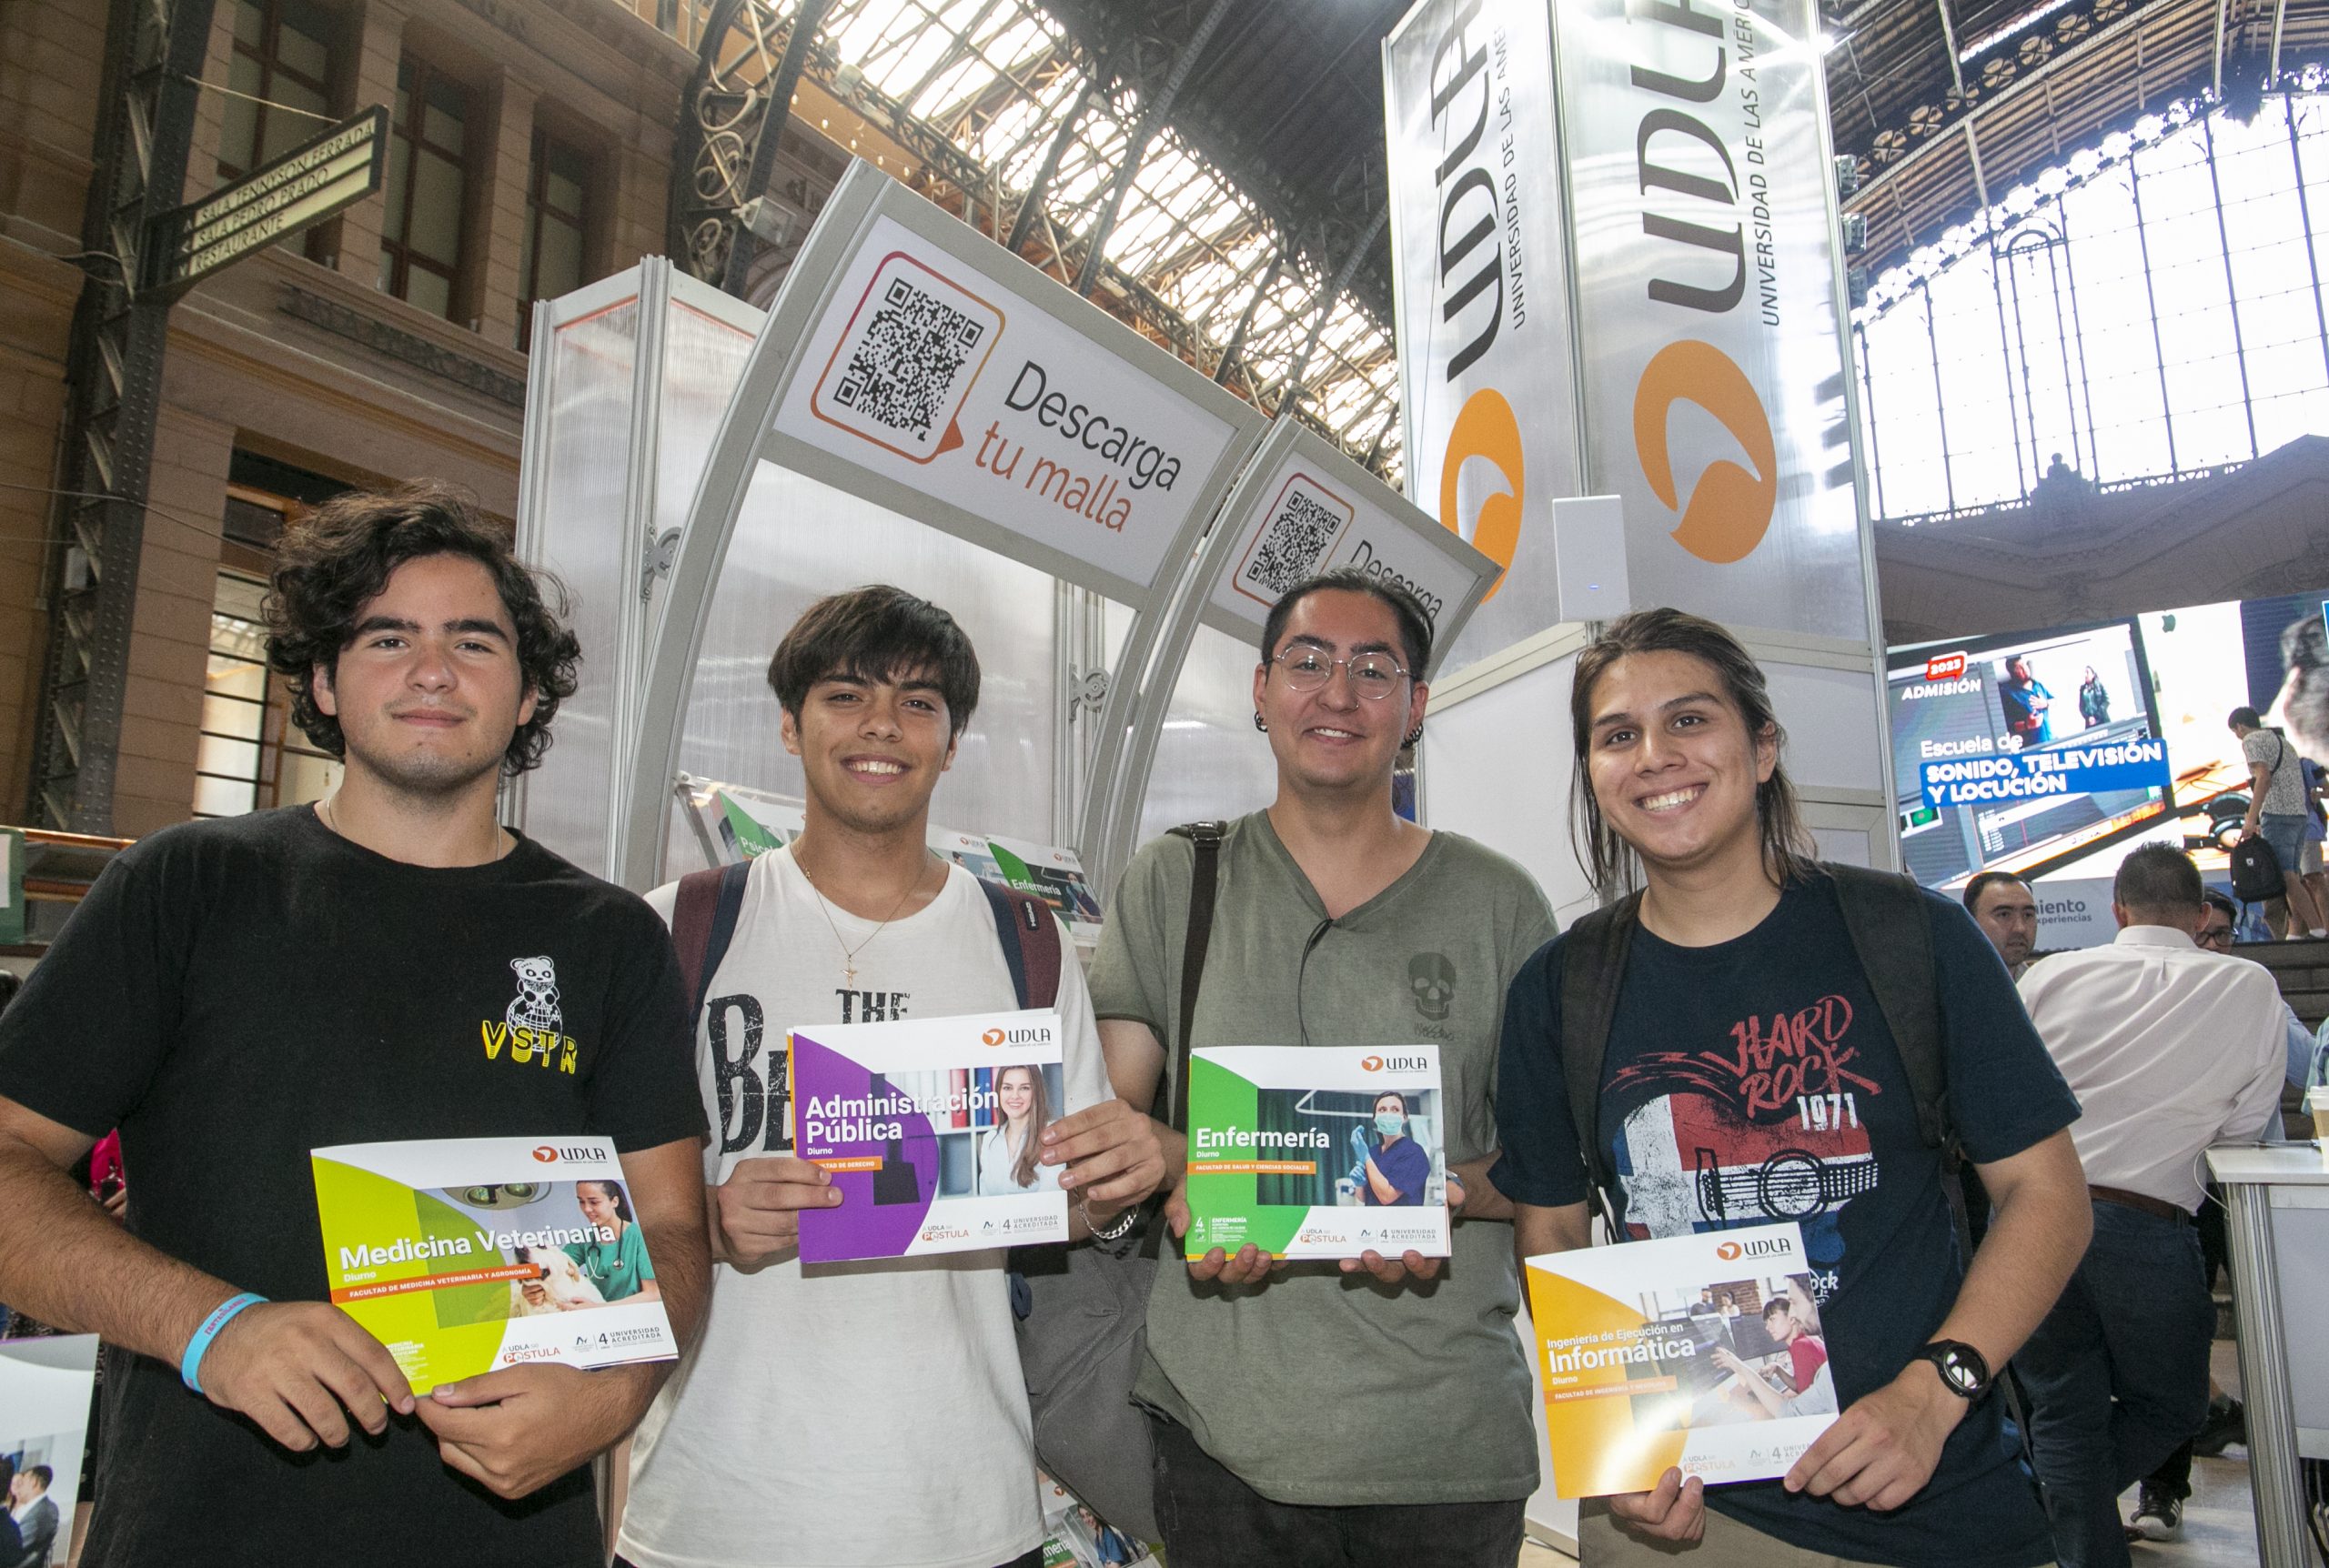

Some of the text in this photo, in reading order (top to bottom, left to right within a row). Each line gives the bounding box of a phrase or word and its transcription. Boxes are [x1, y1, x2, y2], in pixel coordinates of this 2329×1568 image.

[1498, 86, 1513, 129] LAS
[1740, 88, 1761, 129] LAS
[1502, 133, 1516, 169] DE
[1745, 136, 1767, 166] DE
[201, 201, 230, 221] SALA
[312, 123, 372, 166] FERRADA
[197, 167, 328, 246] SALA PEDRO PRADO
[195, 213, 284, 268] RESTAURANTE
[1506, 173, 1526, 330] UNIVERSIDAD
[1749, 174, 1780, 327] UNIVERSIDAD
[1004, 360, 1181, 492] Descarga
[975, 420, 1132, 533] tu malla
[1901, 678, 1981, 700] ADMISIÓN
[1920, 737, 1992, 759] Escuela
[1926, 741, 2163, 783] SONIDO, TELEVISIÓN
[1927, 773, 2067, 804] Y LOCUCIÓN
[1011, 879, 1063, 896] Enfermería
[835, 989, 911, 1024] THE
[482, 1020, 578, 1075] VSTR
[1008, 1028, 1051, 1044] UDLA
[1726, 994, 1853, 1078] HARD
[1386, 1057, 1427, 1070] UDLA
[1739, 1043, 1882, 1120] ROCK
[805, 1084, 999, 1120] Administración
[1796, 1092, 1859, 1131] 1971
[806, 1119, 902, 1144] Pública
[1195, 1126, 1331, 1149] Enfermería
[560, 1148, 607, 1161] UDLA
[807, 1147, 832, 1156] Diurno
[1013, 1214, 1059, 1224] UNIVERSIDAD
[339, 1221, 616, 1271] Medicina Veterinaria
[1380, 1229, 1388, 1240] 4
[1744, 1238, 1791, 1256] UDLA
[343, 1271, 377, 1282] Diurno
[349, 1285, 388, 1298] FACULTAD
[399, 1280, 436, 1290] MEDICINA
[437, 1273, 483, 1284] VETERINARIA
[490, 1267, 532, 1278] AGRONOMÍA
[599, 1332, 609, 1345] 4
[610, 1326, 660, 1338] UNIVERSIDAD
[611, 1332, 661, 1343] ACREDITADA
[1547, 1323, 1684, 1350] Ingeniería de Ejecución en
[508, 1343, 529, 1352] UDLA
[1548, 1336, 1697, 1374] Informática
[1552, 1375, 1578, 1386] Diurno
[1555, 1390, 1585, 1400] FACULTAD
[1771, 1447, 1781, 1460] 4
